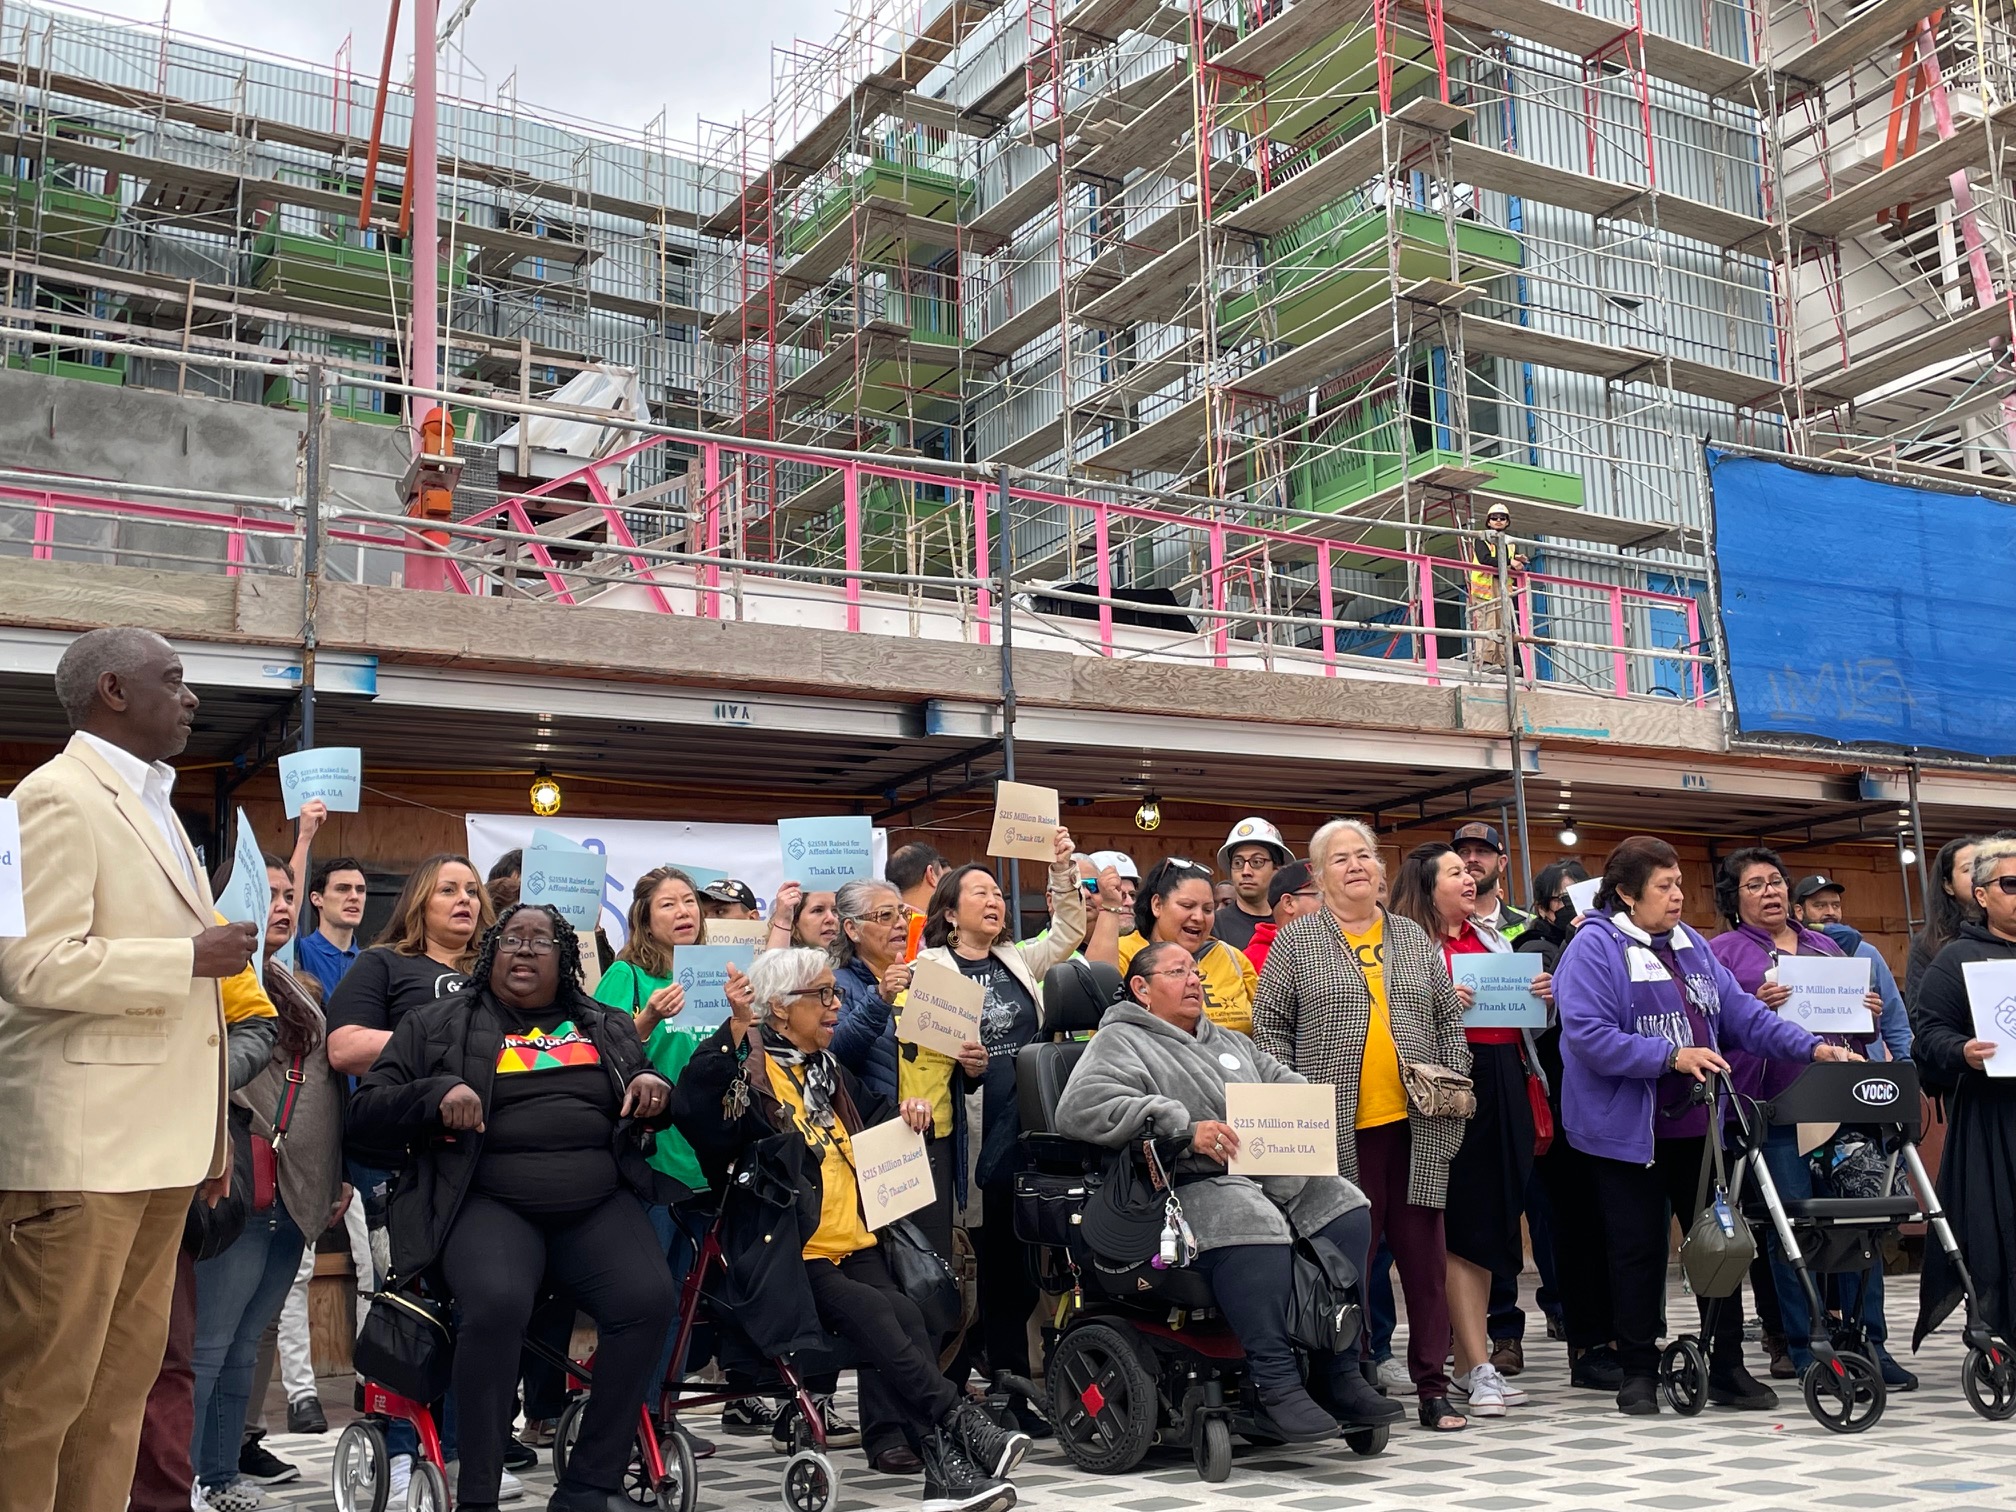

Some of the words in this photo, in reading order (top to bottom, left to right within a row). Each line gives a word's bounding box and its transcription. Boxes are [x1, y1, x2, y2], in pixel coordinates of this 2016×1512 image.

[301, 789, 326, 800] Thank
[327, 789, 343, 797] ULA
[999, 810, 1013, 820] $215
[1013, 812, 1037, 823] Million
[1037, 815, 1057, 825] Raised
[1016, 833, 1034, 842] Thank
[1034, 835, 1045, 844] ULA
[843, 848, 869, 856] Housing
[808, 866, 836, 875] Thank
[837, 866, 855, 875] ULA
[568, 876, 587, 885] Raised
[587, 877, 596, 885] for
[548, 885, 579, 893] Affordable
[579, 886, 600, 897] Housing
[572, 905, 586, 915] ULA
[1501, 976, 1522, 984] Raised
[1805, 985, 1836, 995] Million
[1837, 986, 1865, 995] Raised
[693, 999, 719, 1009] Thank
[913, 988, 930, 1002] $215
[930, 995, 958, 1015] Million
[957, 1006, 978, 1024] Raised
[1478, 1002, 1507, 1011] Thank
[1508, 1003, 1527, 1011] ULA
[1813, 1006, 1836, 1014] Thank
[1837, 1006, 1852, 1015] ULA
[931, 1020, 953, 1035] Thank
[953, 1029, 967, 1041] ULA
[1233, 1117, 1255, 1130] $215
[1257, 1118, 1294, 1129] Million
[1296, 1119, 1330, 1129] Raised
[1267, 1144, 1295, 1153] Thank
[1297, 1144, 1316, 1154] ULA
[862, 1166, 878, 1182] $215
[878, 1157, 902, 1176] Million
[902, 1147, 923, 1164] Raised
[889, 1184, 908, 1198] Thank
[907, 1177, 920, 1189] ULA
